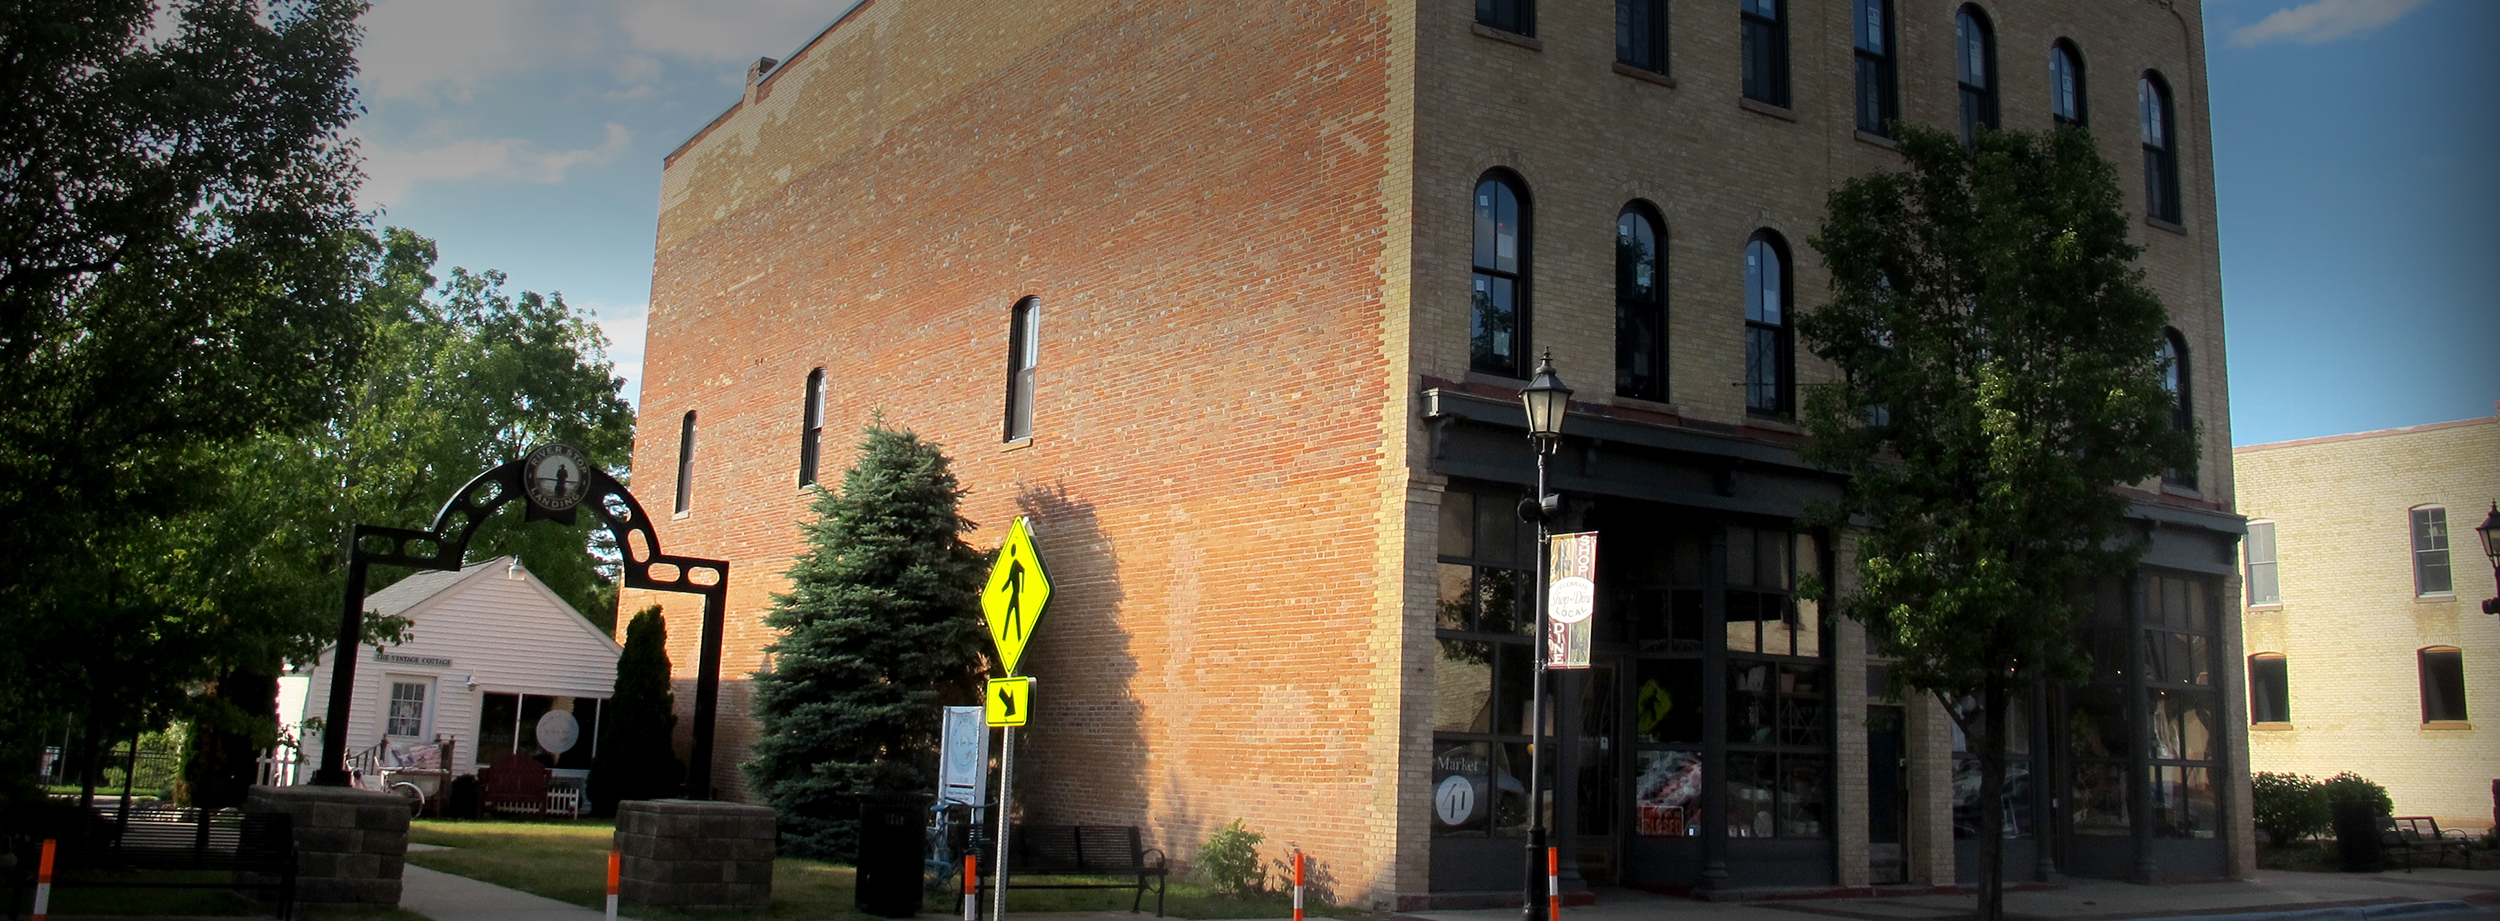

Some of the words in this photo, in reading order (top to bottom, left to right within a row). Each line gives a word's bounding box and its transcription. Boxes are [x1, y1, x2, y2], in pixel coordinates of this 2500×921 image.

[531, 446, 562, 466] RIVER
[566, 448, 588, 474] STOP
[530, 487, 581, 508] LANDING
[1577, 535, 1592, 576] SHOP
[1555, 581, 1589, 592] CELEBRATE
[1550, 591, 1570, 608] Shop
[1573, 590, 1593, 605] Dine
[1555, 606, 1588, 618] LOCAL
[1553, 622, 1565, 664] DINE
[391, 655, 419, 663] VINTAGE
[421, 657, 452, 665] COTTAGE
[1437, 756, 1478, 771] Market
[1644, 818, 1681, 835] CLOSED
